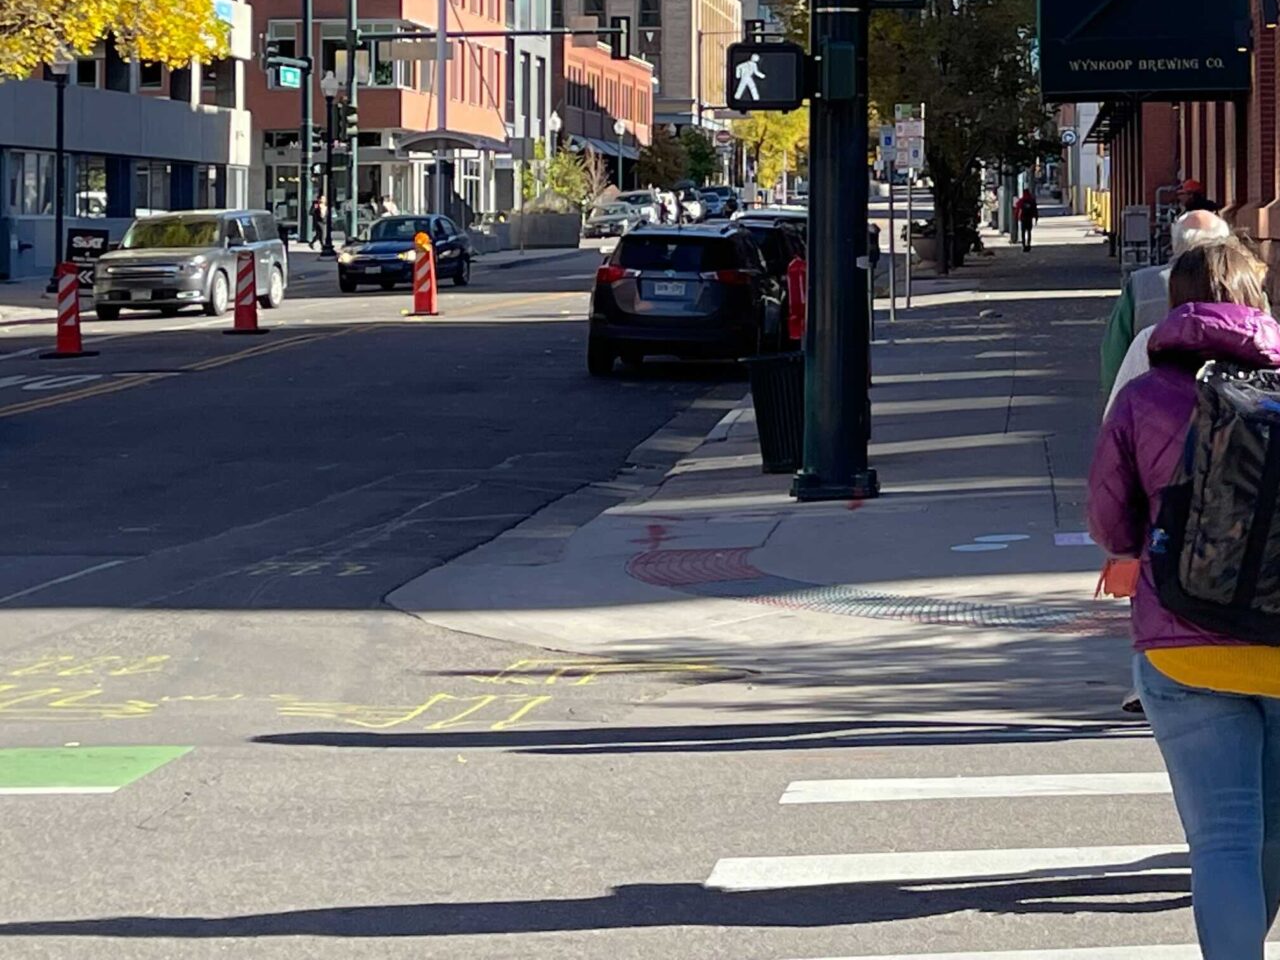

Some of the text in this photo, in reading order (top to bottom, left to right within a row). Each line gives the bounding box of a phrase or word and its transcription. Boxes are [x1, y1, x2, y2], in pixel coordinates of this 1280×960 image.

[1069, 57, 1225, 72] WYNKOOP BREWING CO.
